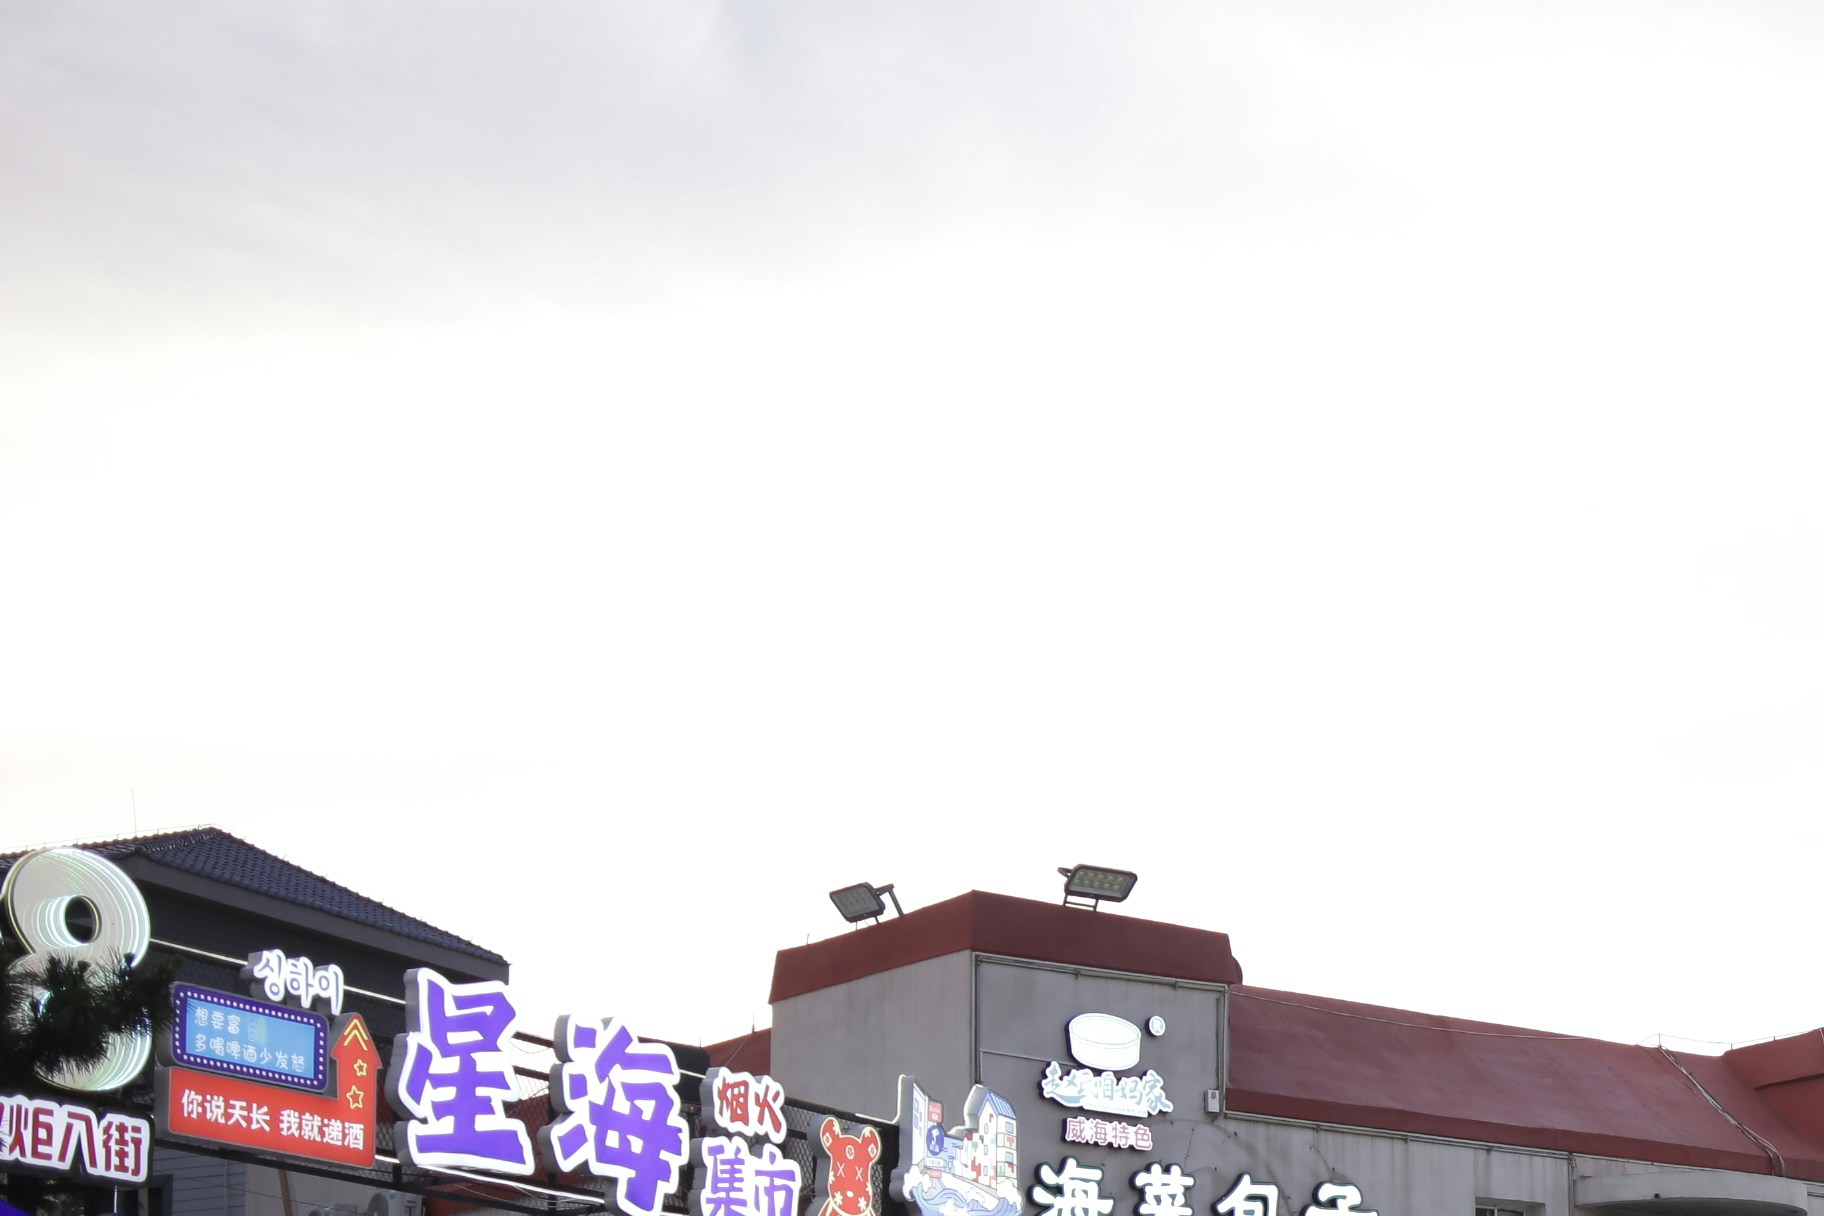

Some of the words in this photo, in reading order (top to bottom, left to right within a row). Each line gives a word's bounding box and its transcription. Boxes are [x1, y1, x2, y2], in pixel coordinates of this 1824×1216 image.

[255, 951, 342, 1013] 싱하이
[195, 1008, 240, 1034] 想要富
[195, 1033, 305, 1072] 多喝啤酒少发怒
[182, 1089, 270, 1132] 你说天长
[279, 1110, 365, 1150] 我就递酒
[717, 1077, 784, 1136] 烟火
[1067, 1120, 1151, 1149] 威海特色
[0, 1100, 142, 1177] 炬八街
